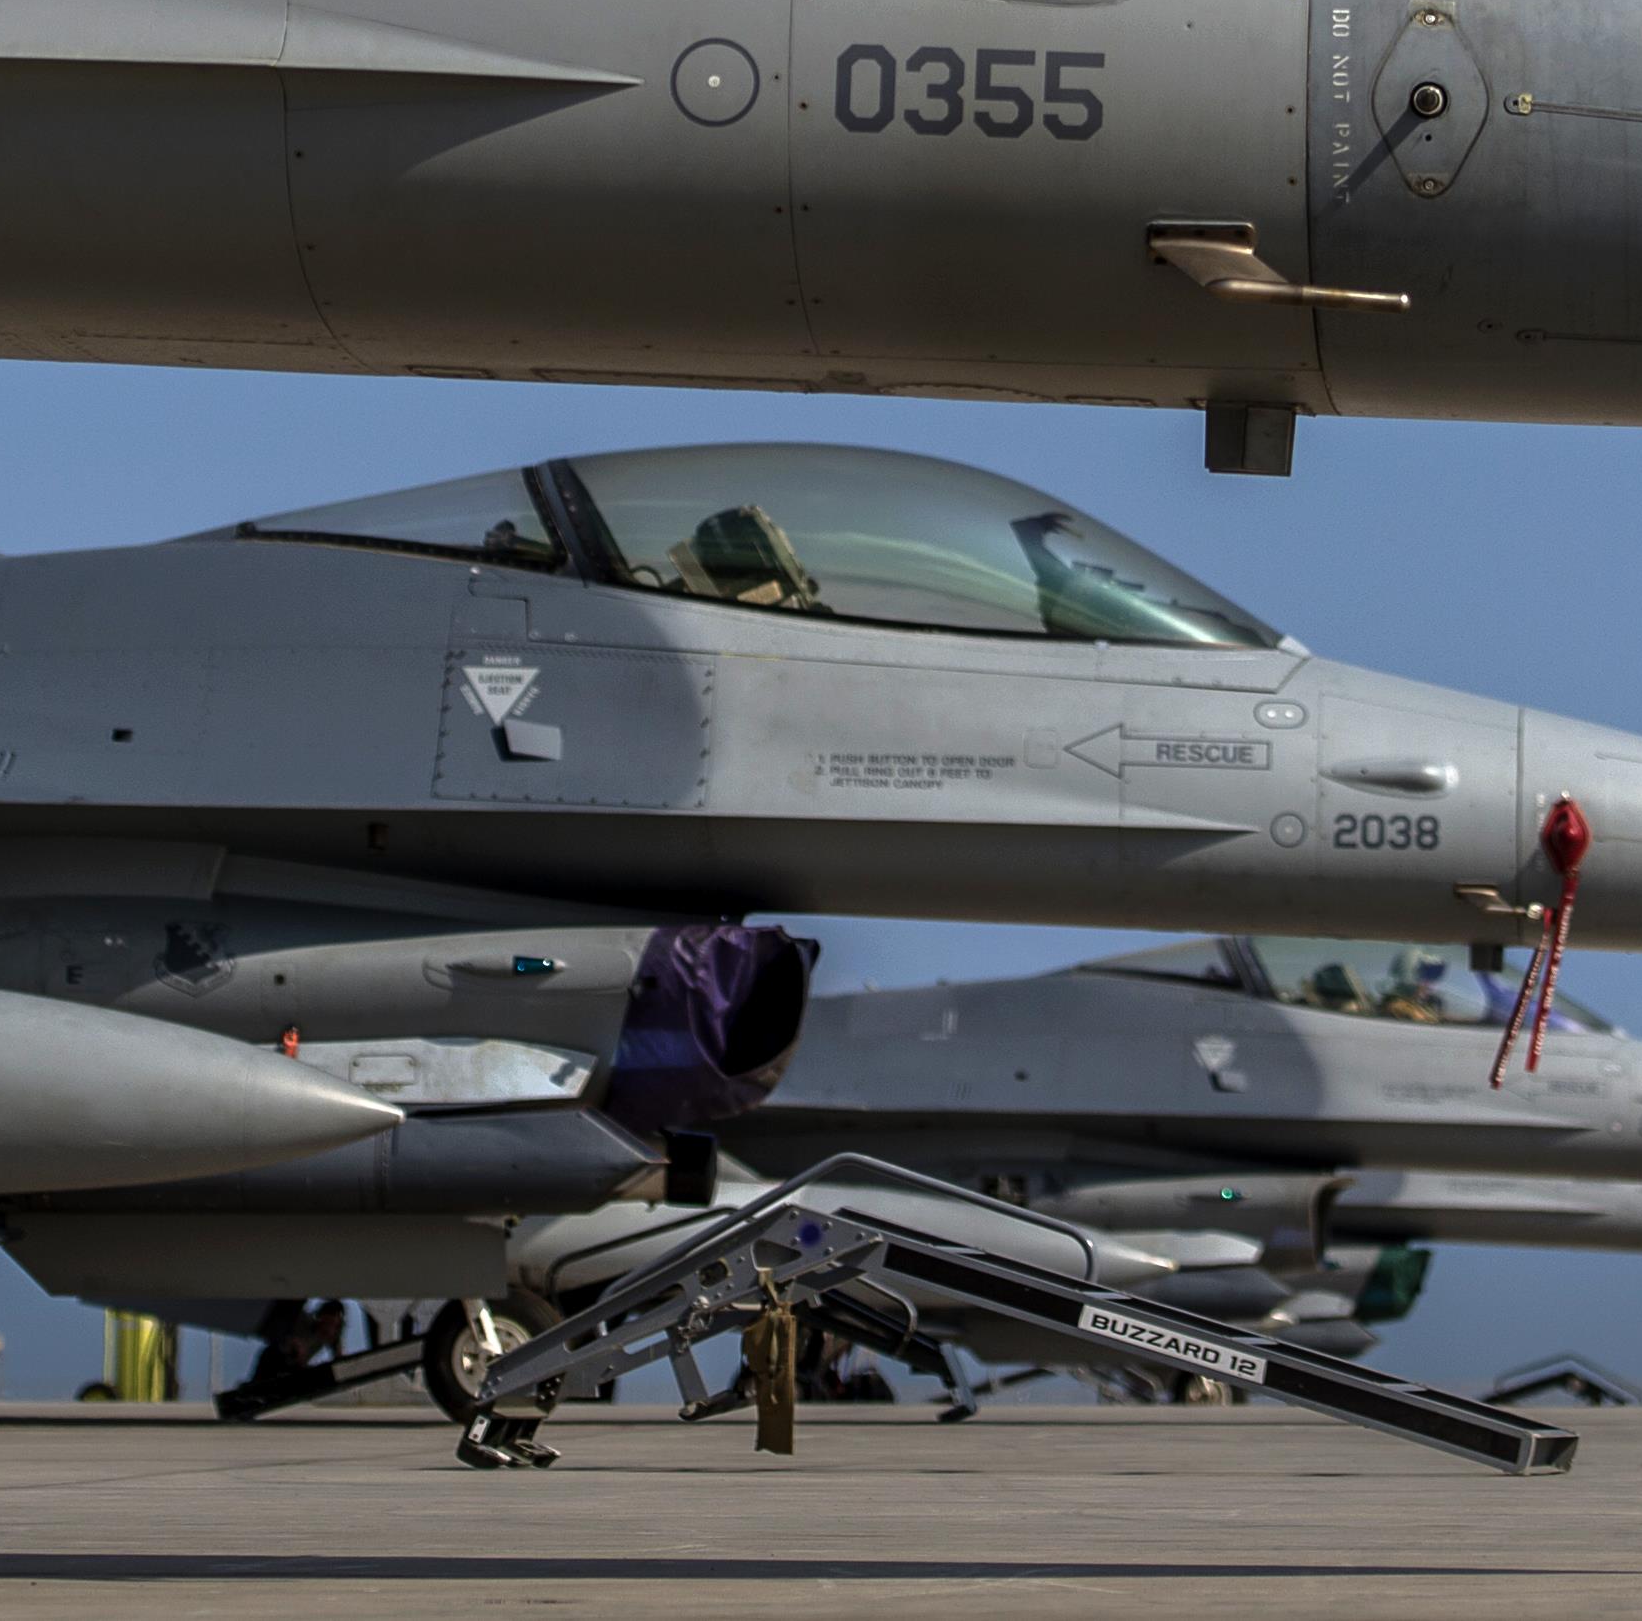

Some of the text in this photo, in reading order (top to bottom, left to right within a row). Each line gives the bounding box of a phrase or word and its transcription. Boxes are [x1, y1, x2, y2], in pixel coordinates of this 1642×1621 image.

[834, 43, 1106, 140] 0355
[1332, 9, 1350, 204] DO NOT PAINT
[1156, 741, 1254, 764] RESCUE
[1333, 814, 1440, 850] 2038
[1091, 1314, 1257, 1377] BUZZARD 12
